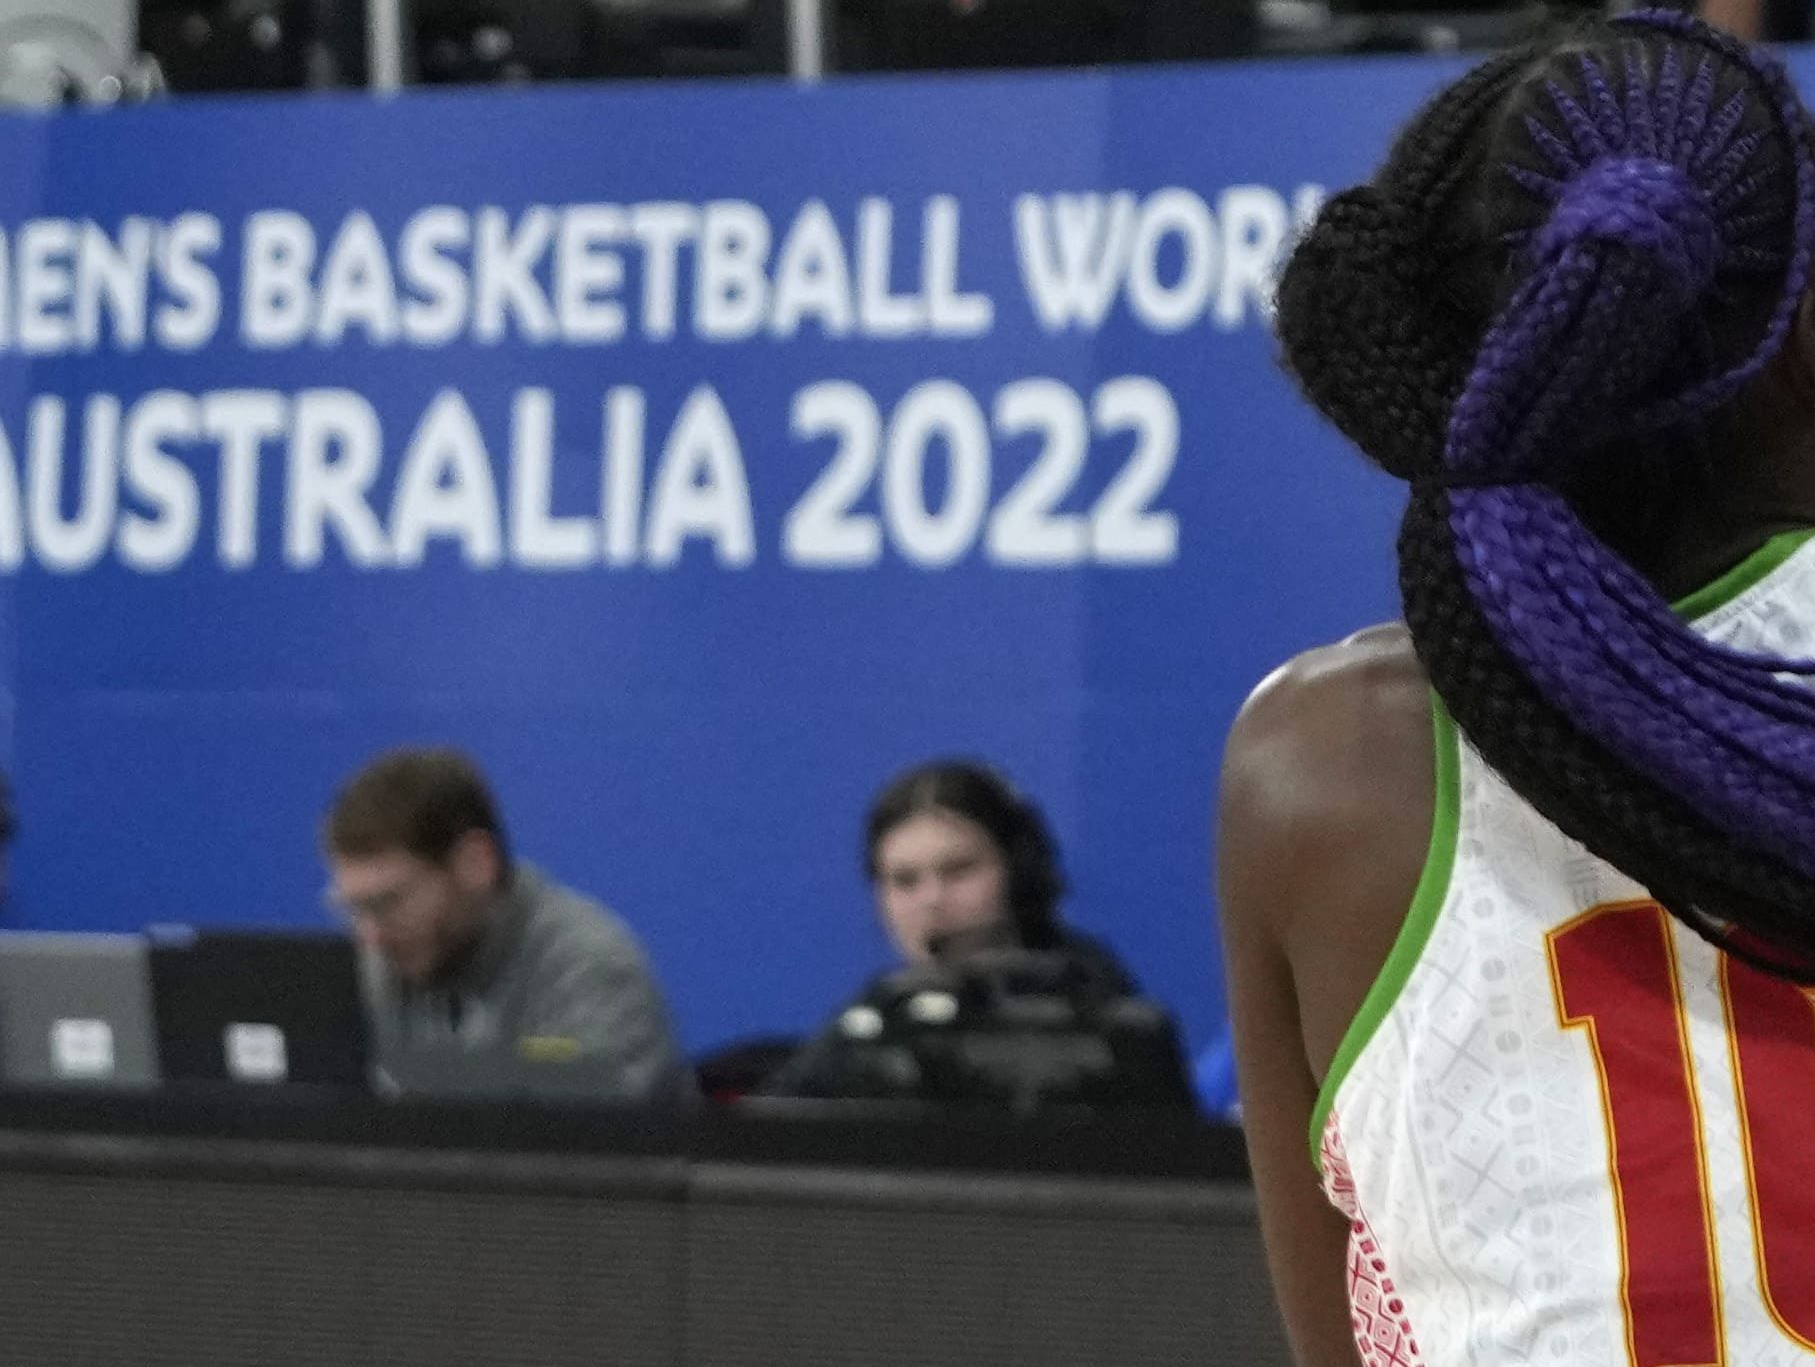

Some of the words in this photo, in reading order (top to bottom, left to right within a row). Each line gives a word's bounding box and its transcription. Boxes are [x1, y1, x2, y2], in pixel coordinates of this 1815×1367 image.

[0, 212, 222, 353] EN'S
[242, 195, 992, 349] BASKETBALL
[784, 375, 1180, 569] 2022
